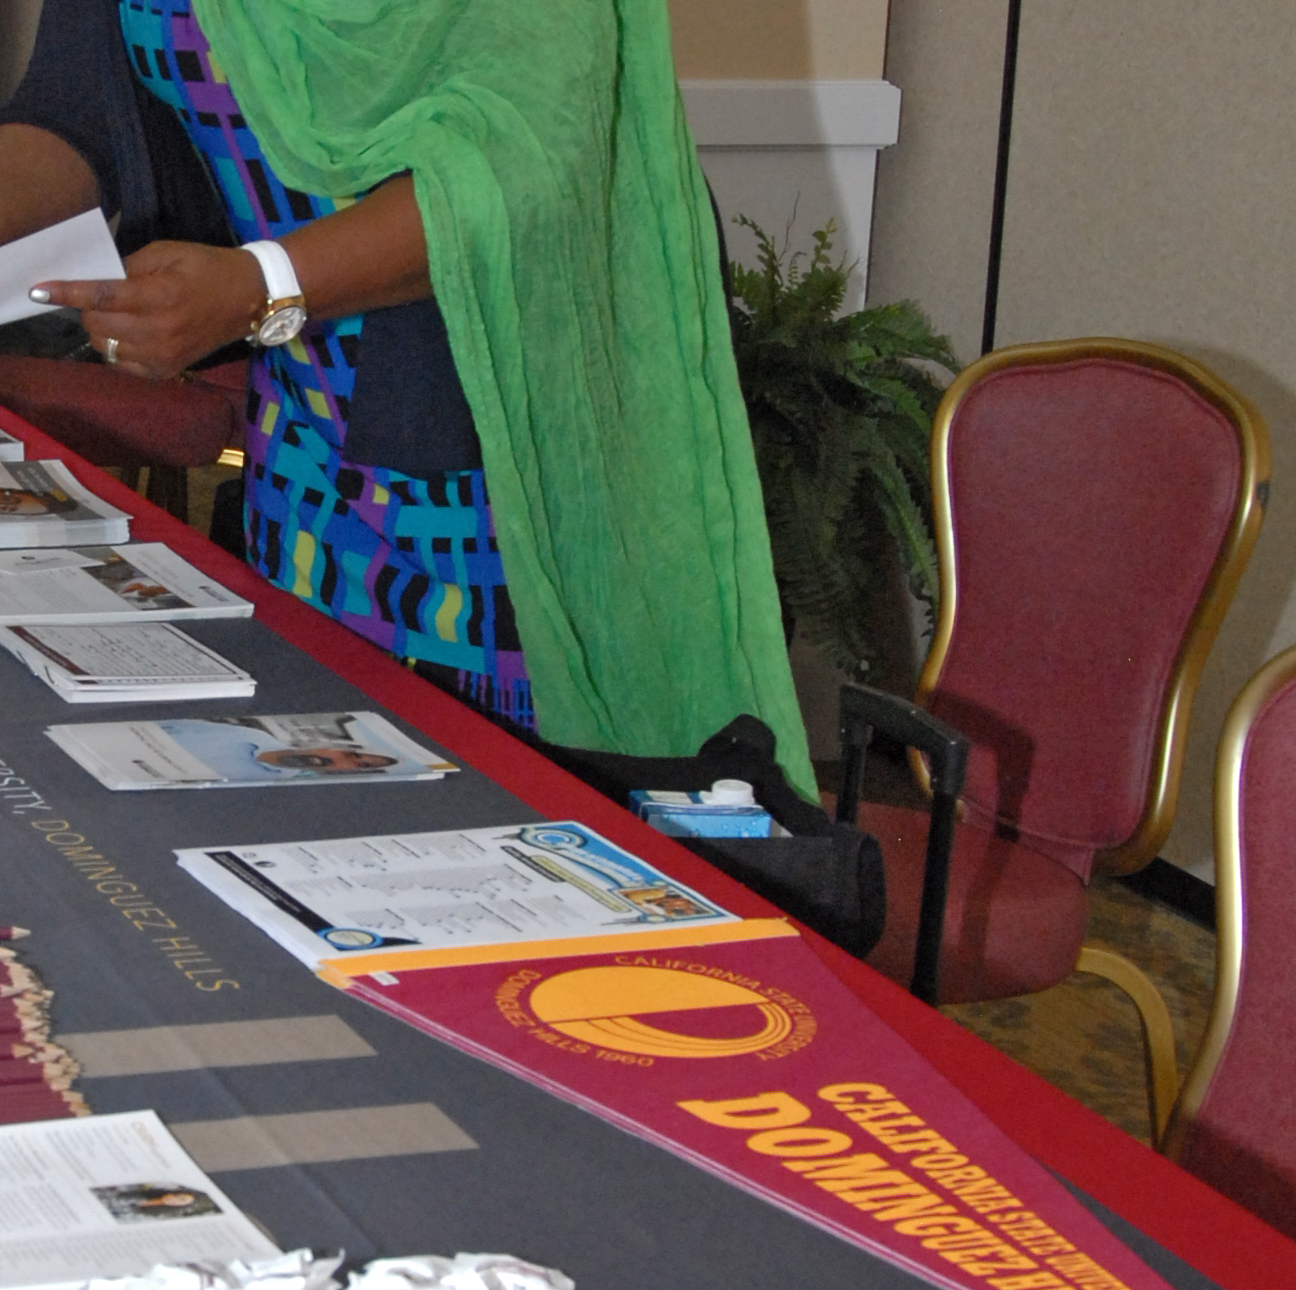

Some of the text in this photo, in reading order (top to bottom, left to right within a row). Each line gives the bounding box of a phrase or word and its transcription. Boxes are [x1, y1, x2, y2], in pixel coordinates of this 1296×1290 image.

[31, 820, 177, 931] DOMINGUEZ
[152, 936, 240, 992] HILLS
[614, 955, 761, 990] CALIFORNIA
[759, 987, 811, 1015] STATE
[526, 1028, 591, 1054] HILLS
[595, 1048, 655, 1068] 1960
[676, 1091, 1039, 1276] DOMINGUEZ
[817, 1081, 1024, 1222] CALIFORNIA
[986, 1210, 1077, 1256] STATE
